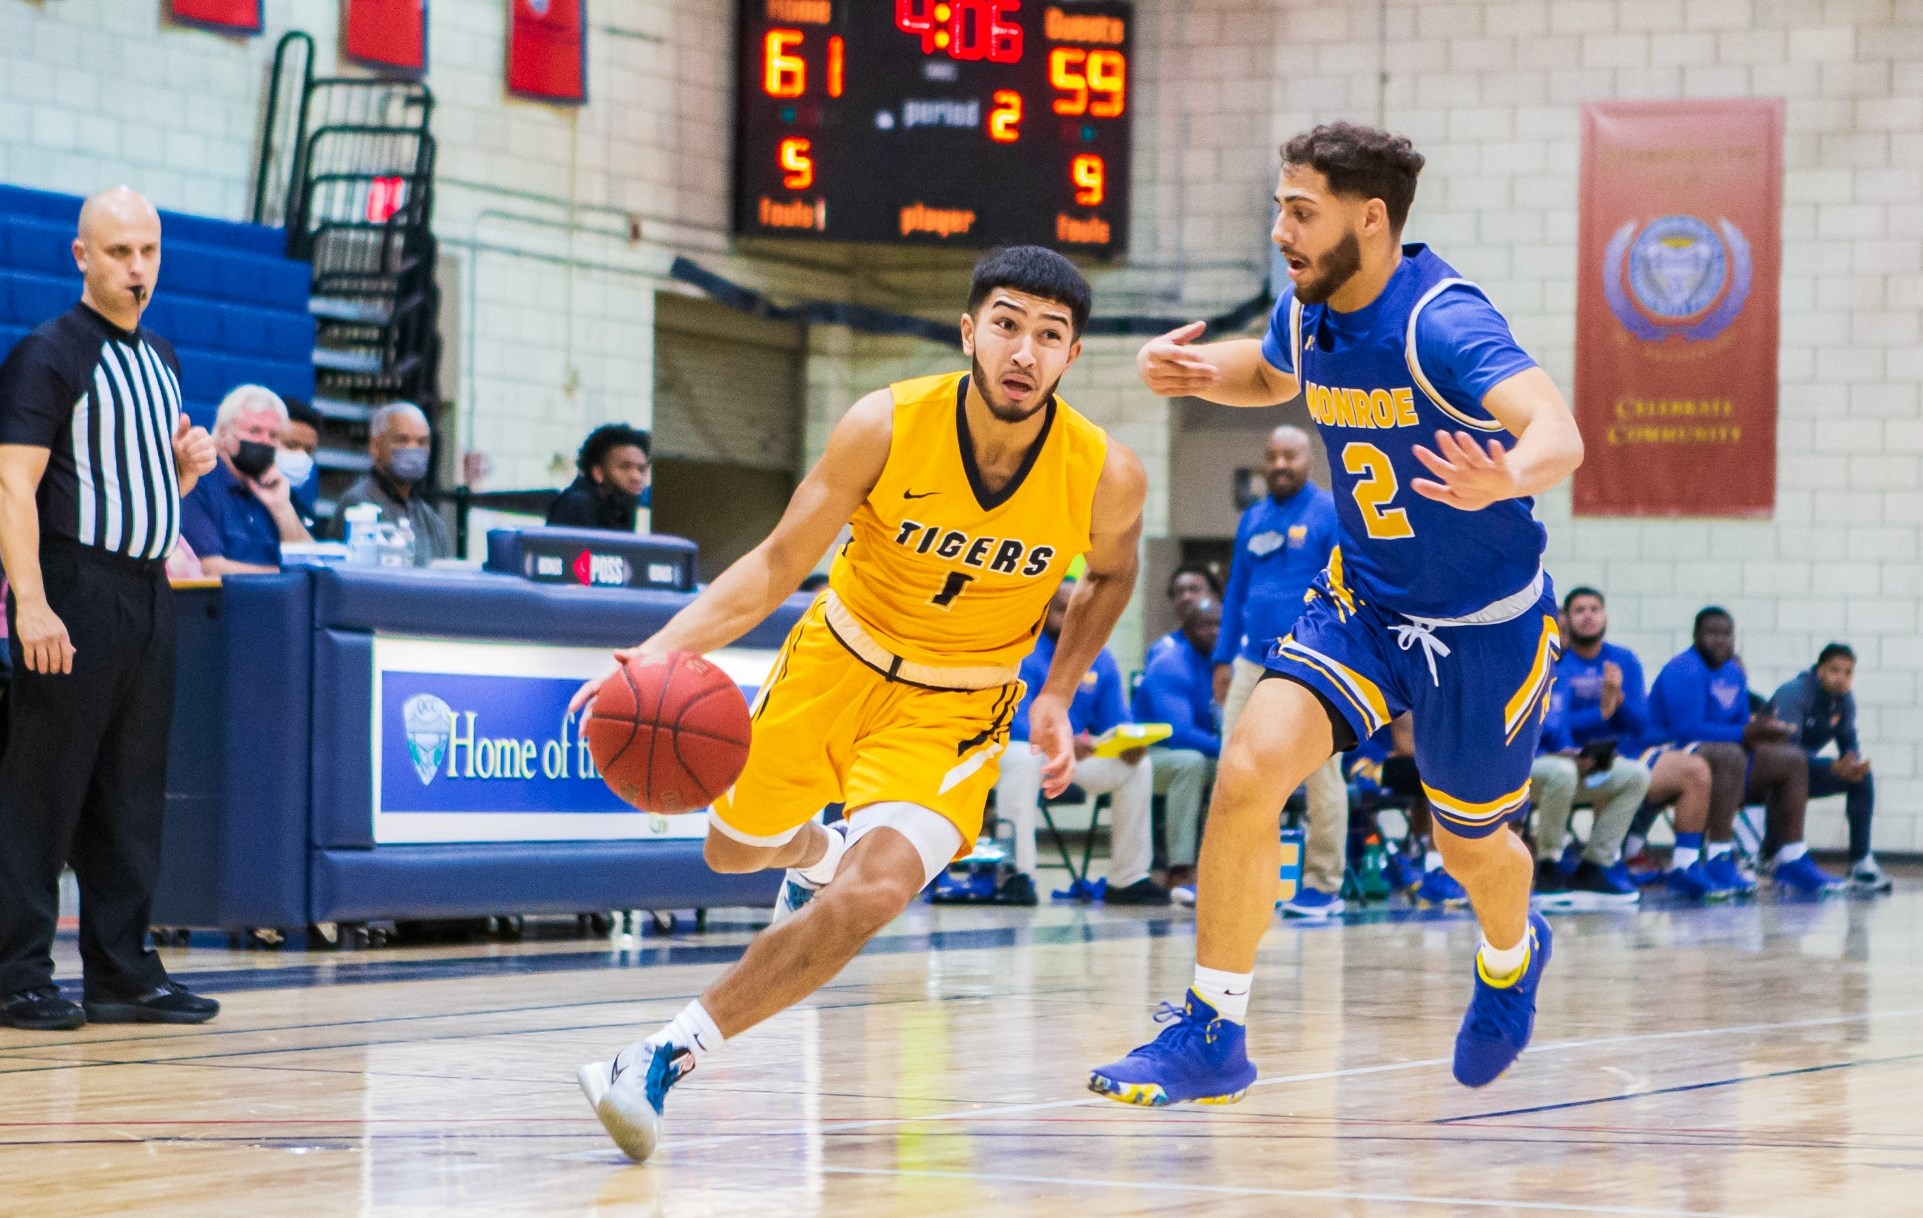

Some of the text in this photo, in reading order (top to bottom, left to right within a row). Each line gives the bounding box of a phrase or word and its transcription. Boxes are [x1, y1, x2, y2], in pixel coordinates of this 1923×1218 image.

[1048, 47, 1125, 117] 59
[988, 90, 1023, 142] 2
[778, 136, 813, 189] 5
[1069, 154, 1105, 205] 9
[1305, 380, 1419, 429] MONROE
[1341, 441, 1415, 540] 2
[894, 519, 1056, 578] TIGERS
[926, 570, 979, 612] 1
[446, 710, 536, 781] Home
[542, 711, 576, 780] of
